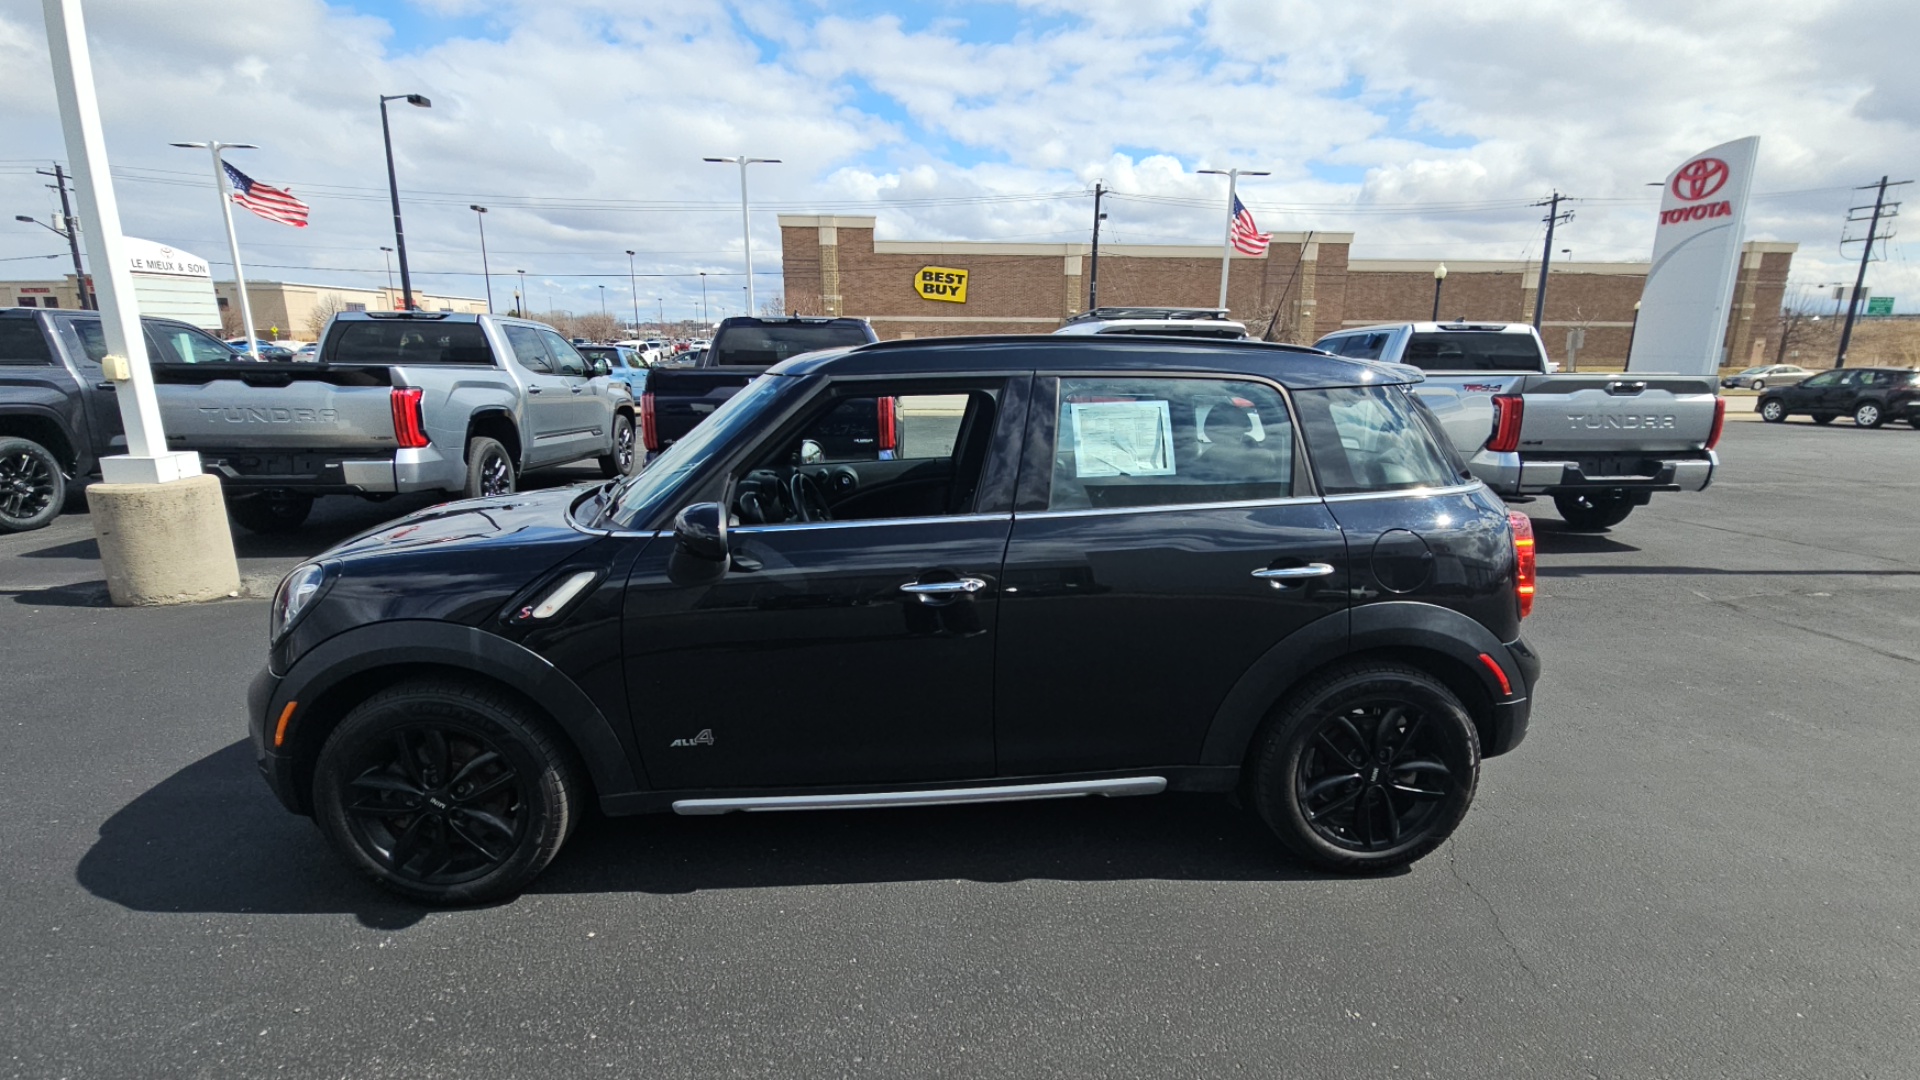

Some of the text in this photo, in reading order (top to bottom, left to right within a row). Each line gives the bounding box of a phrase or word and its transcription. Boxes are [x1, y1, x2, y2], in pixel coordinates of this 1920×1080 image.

[1660, 200, 1732, 225] TOYOTA
[130, 258, 207, 274] LE MIEUX & SON
[922, 271, 966, 285] BEST
[923, 283, 960, 297] BUY
[199, 407, 340, 424] TUNDRA
[1566, 414, 1677, 429] TUNDRA
[518, 605, 533, 619] S
